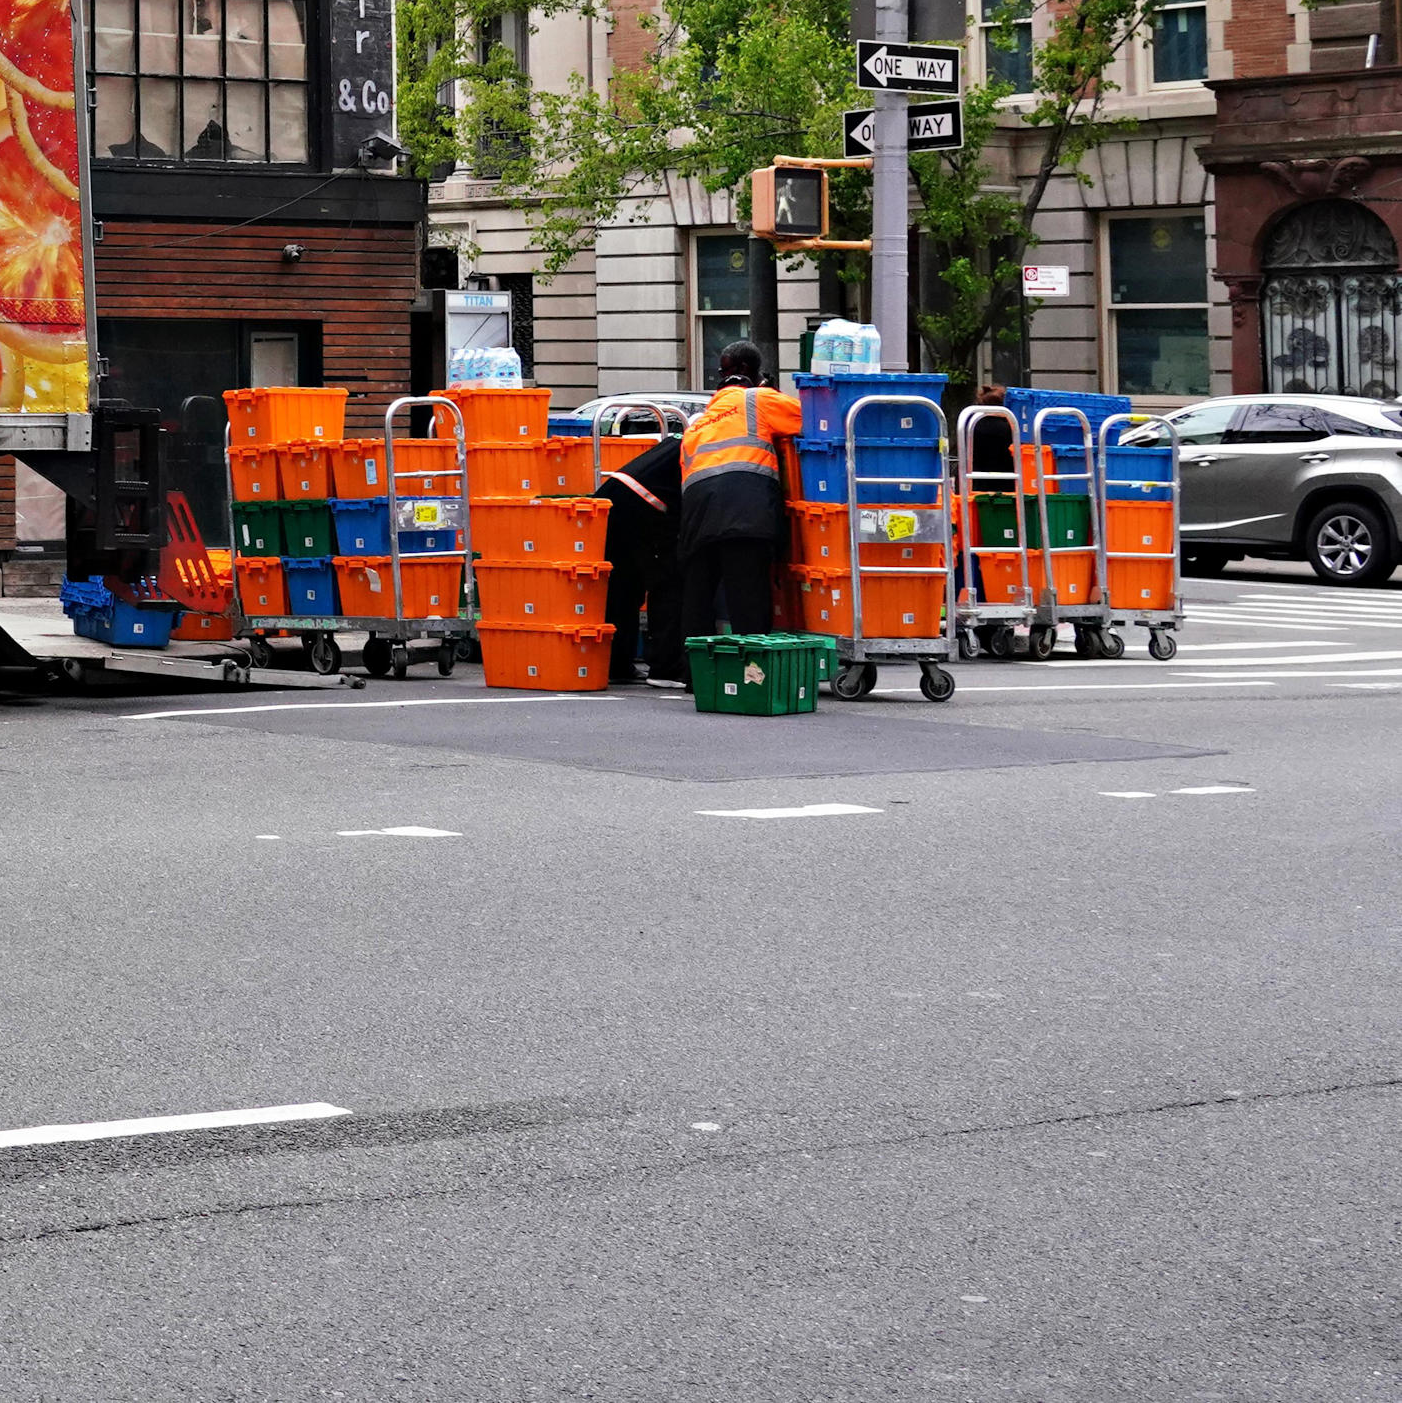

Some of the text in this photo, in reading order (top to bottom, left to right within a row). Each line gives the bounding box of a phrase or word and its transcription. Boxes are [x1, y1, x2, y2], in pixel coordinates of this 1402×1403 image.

[875, 58, 946, 78] ONE WAY
[338, 78, 390, 115] & Co
[909, 117, 944, 136] WAY
[464, 295, 493, 307] TITAN
